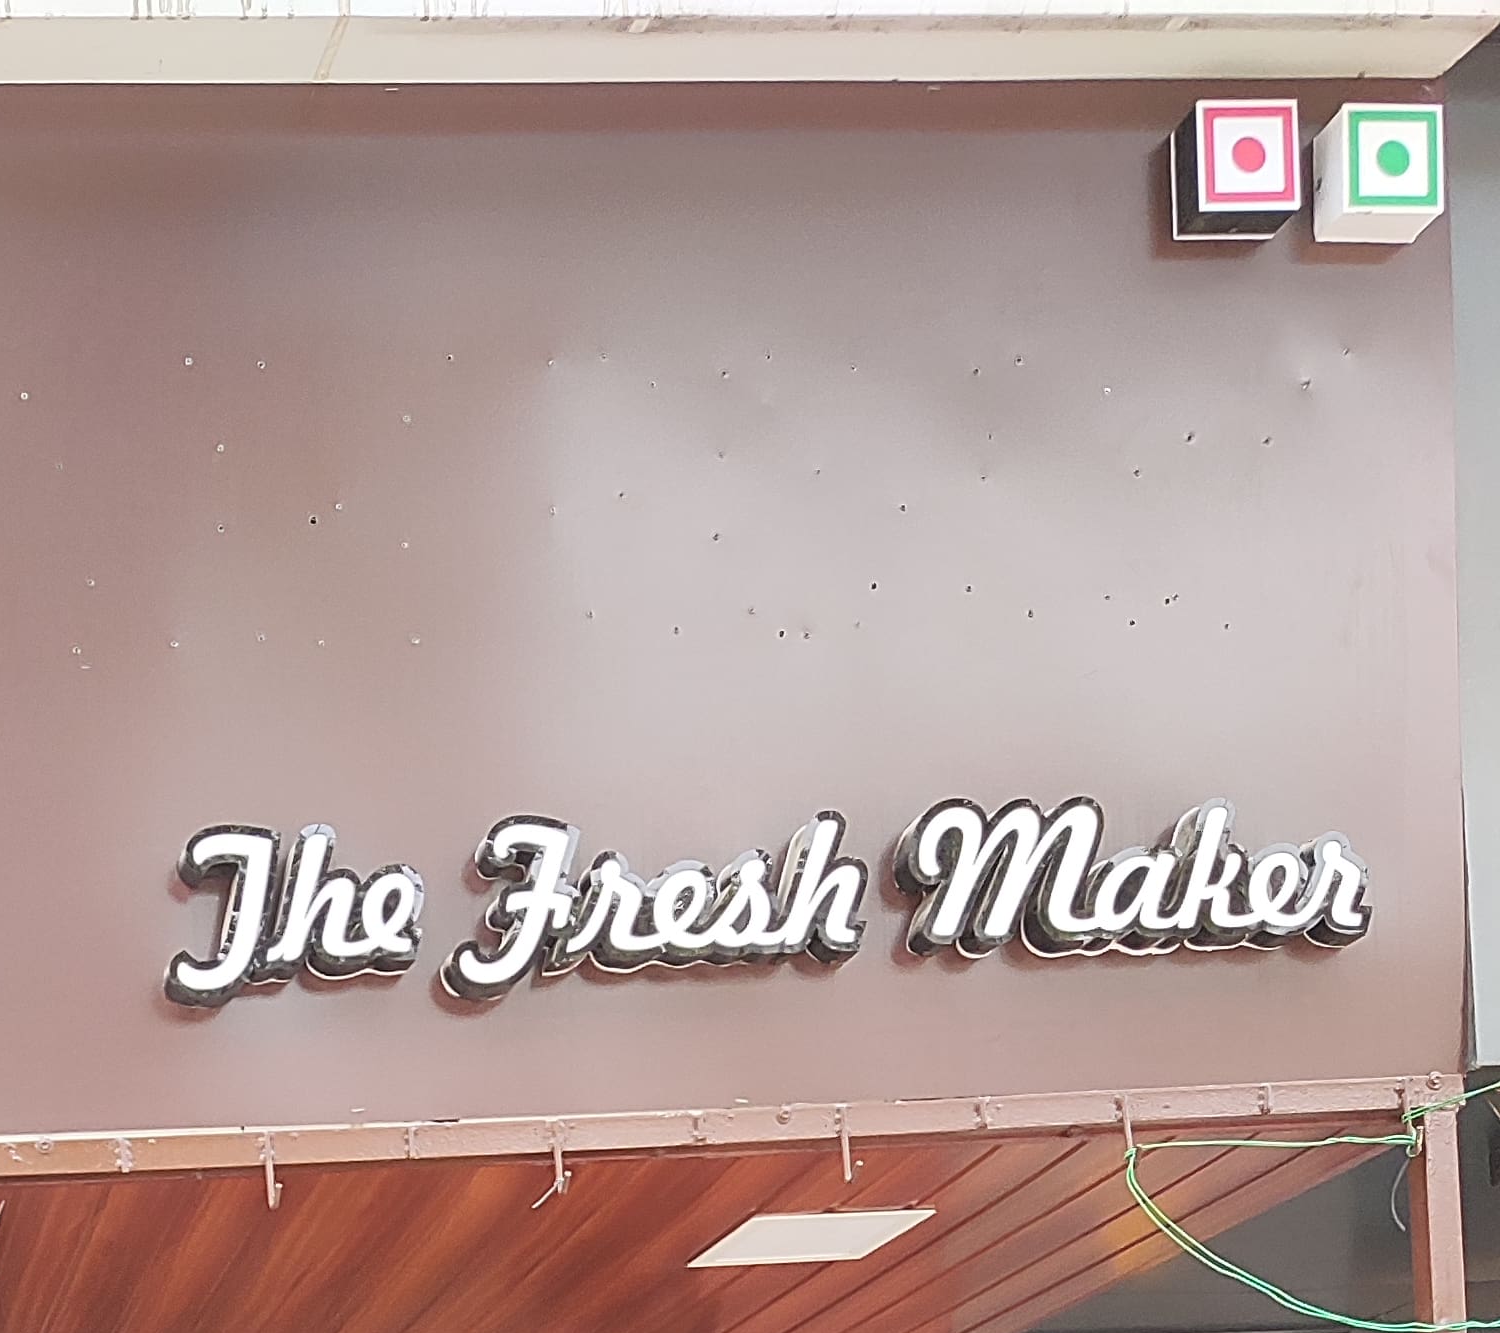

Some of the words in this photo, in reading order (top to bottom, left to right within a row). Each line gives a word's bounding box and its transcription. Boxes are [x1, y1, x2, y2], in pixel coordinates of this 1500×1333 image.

[169, 823, 421, 996] The
[443, 812, 865, 996] Fresh
[905, 799, 1372, 960] Maker
